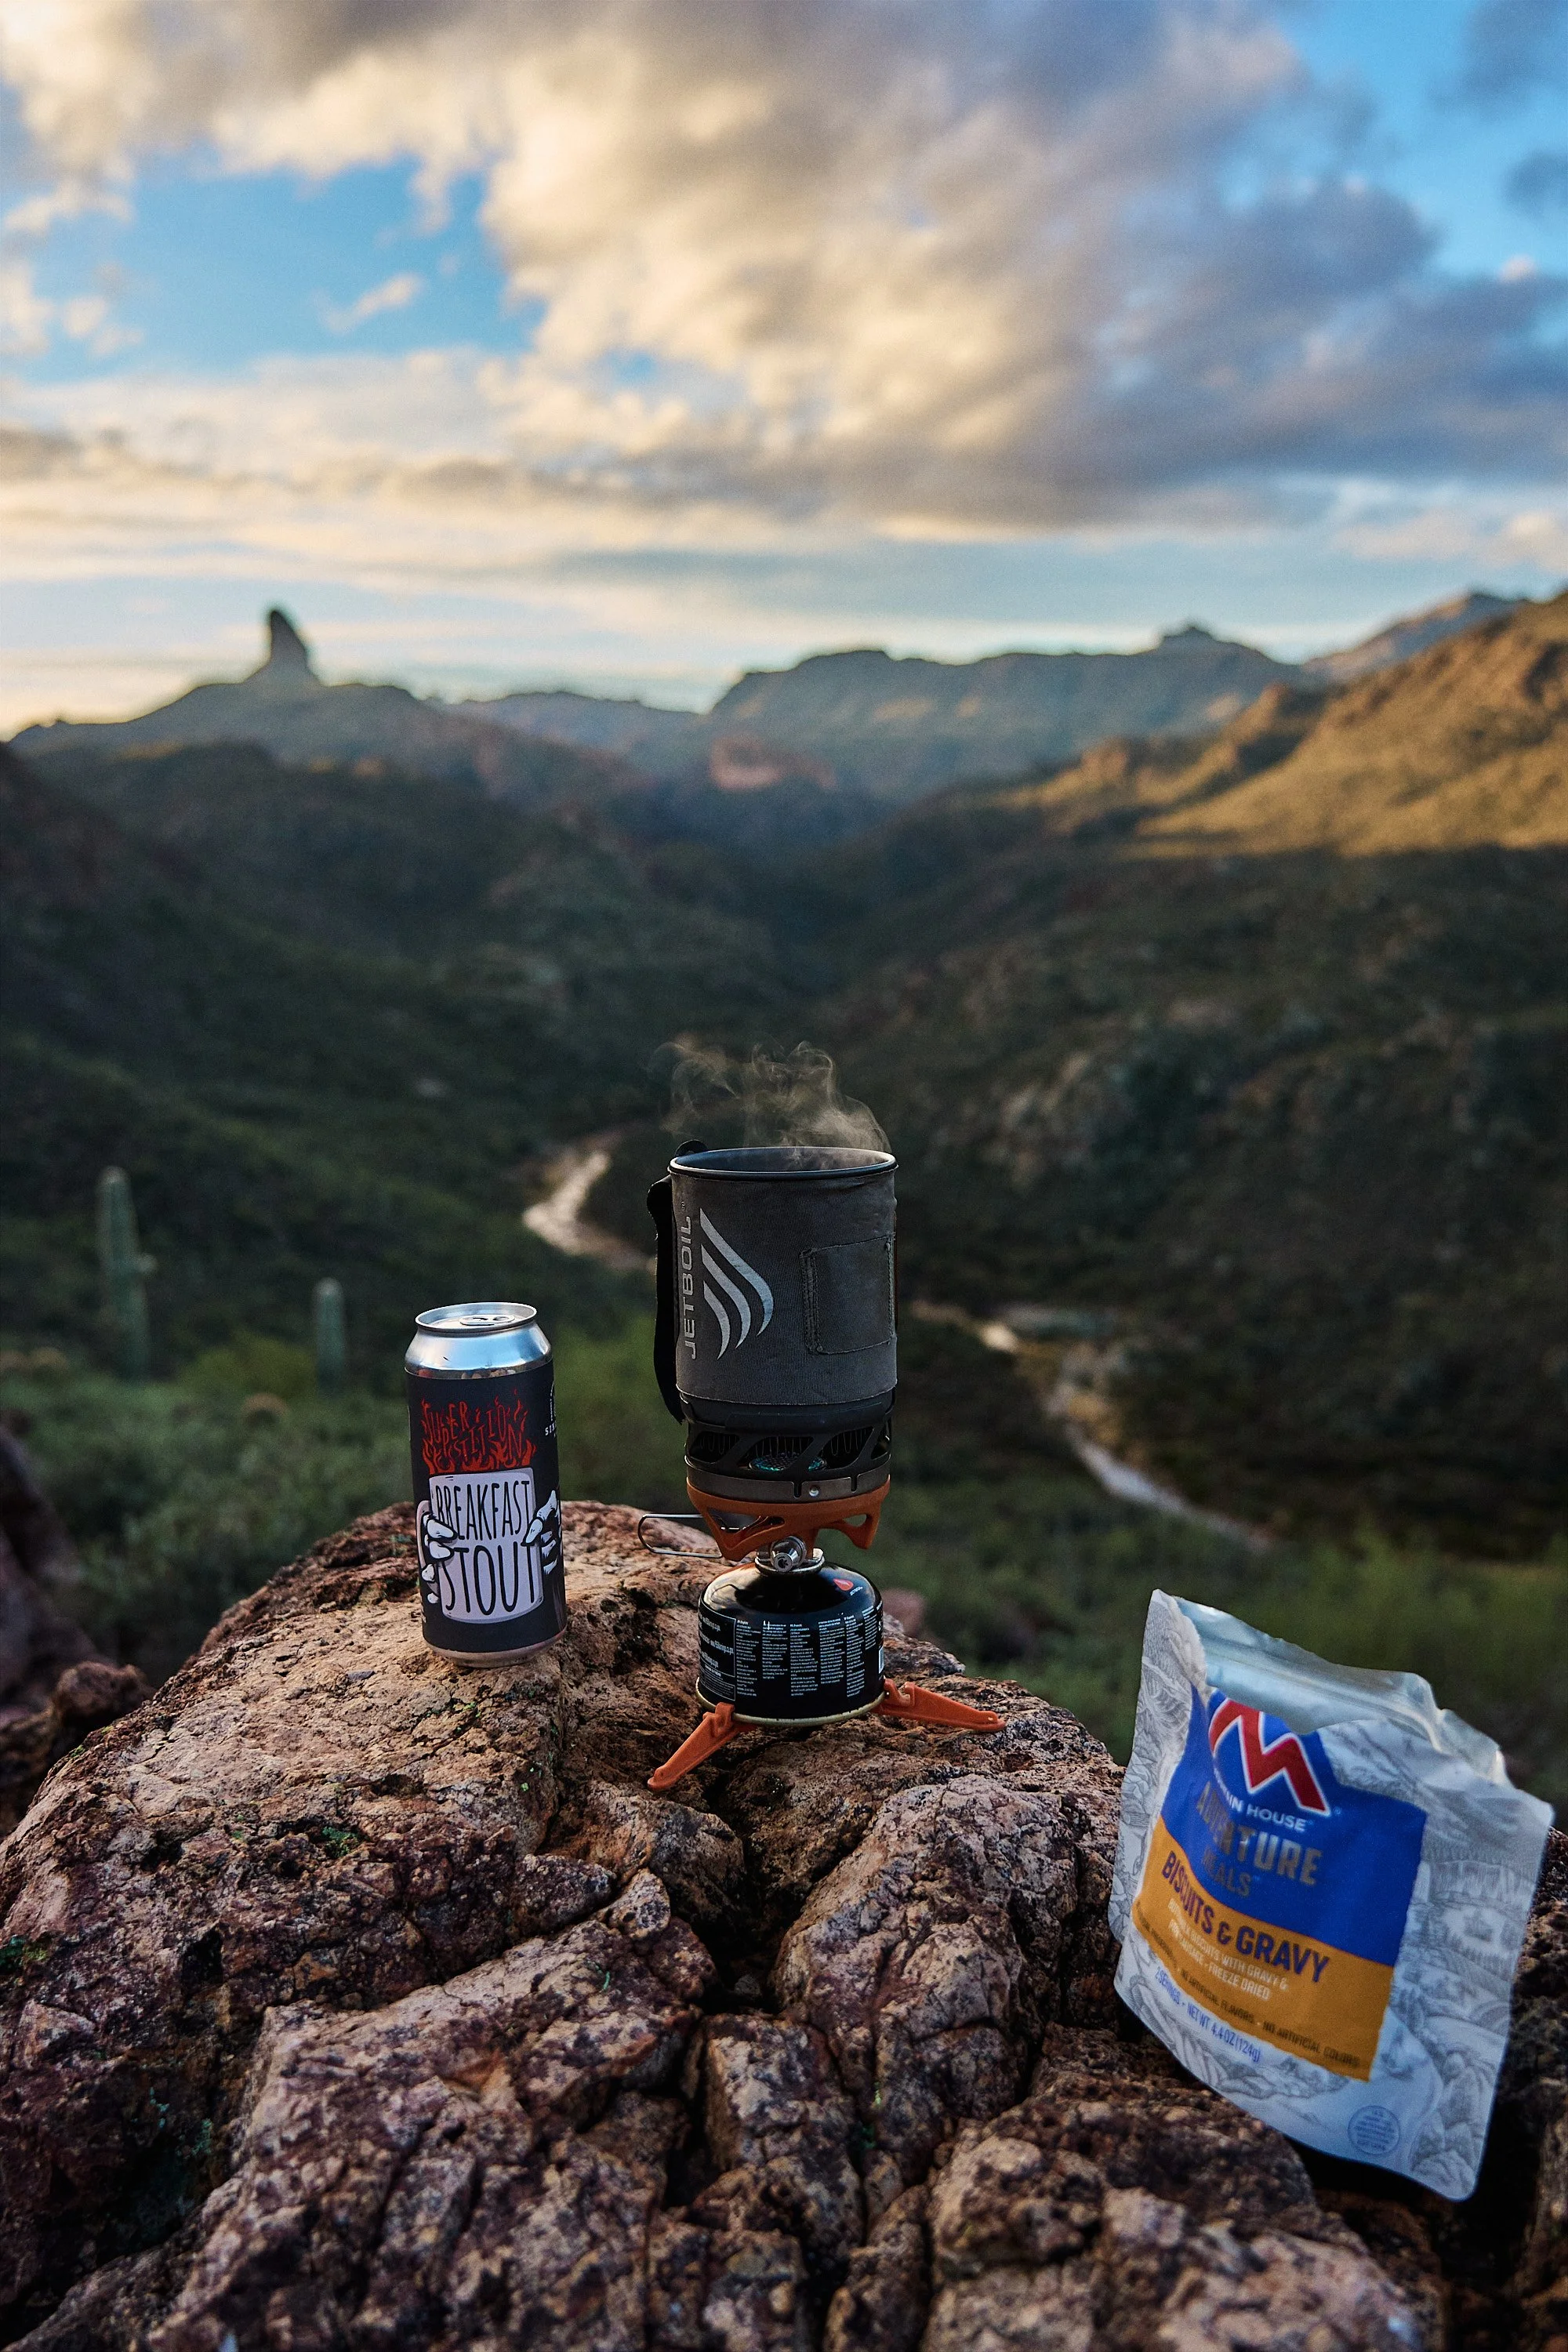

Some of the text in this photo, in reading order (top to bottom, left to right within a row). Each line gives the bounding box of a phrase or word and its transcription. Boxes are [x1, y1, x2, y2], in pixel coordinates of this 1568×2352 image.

[681, 1216, 696, 1360] JETBOIL
[435, 1479, 531, 1541] BREAKFAST
[441, 1541, 539, 1617] STOUT
[1245, 1802, 1308, 1833] HOUSE
[1217, 1921, 1232, 1945] &
[1236, 1926, 1330, 1983] GRAVY
[1221, 1955, 1245, 1973] WITH
[1247, 1964, 1279, 1986] GRAVY
[1279, 1976, 1288, 1991] &
[1208, 1961, 1241, 1988] FREEZE
[1240, 1977, 1270, 2002] DRIED
[1187, 2002, 1200, 2021] NET
[1200, 2010, 1210, 2030] WT
